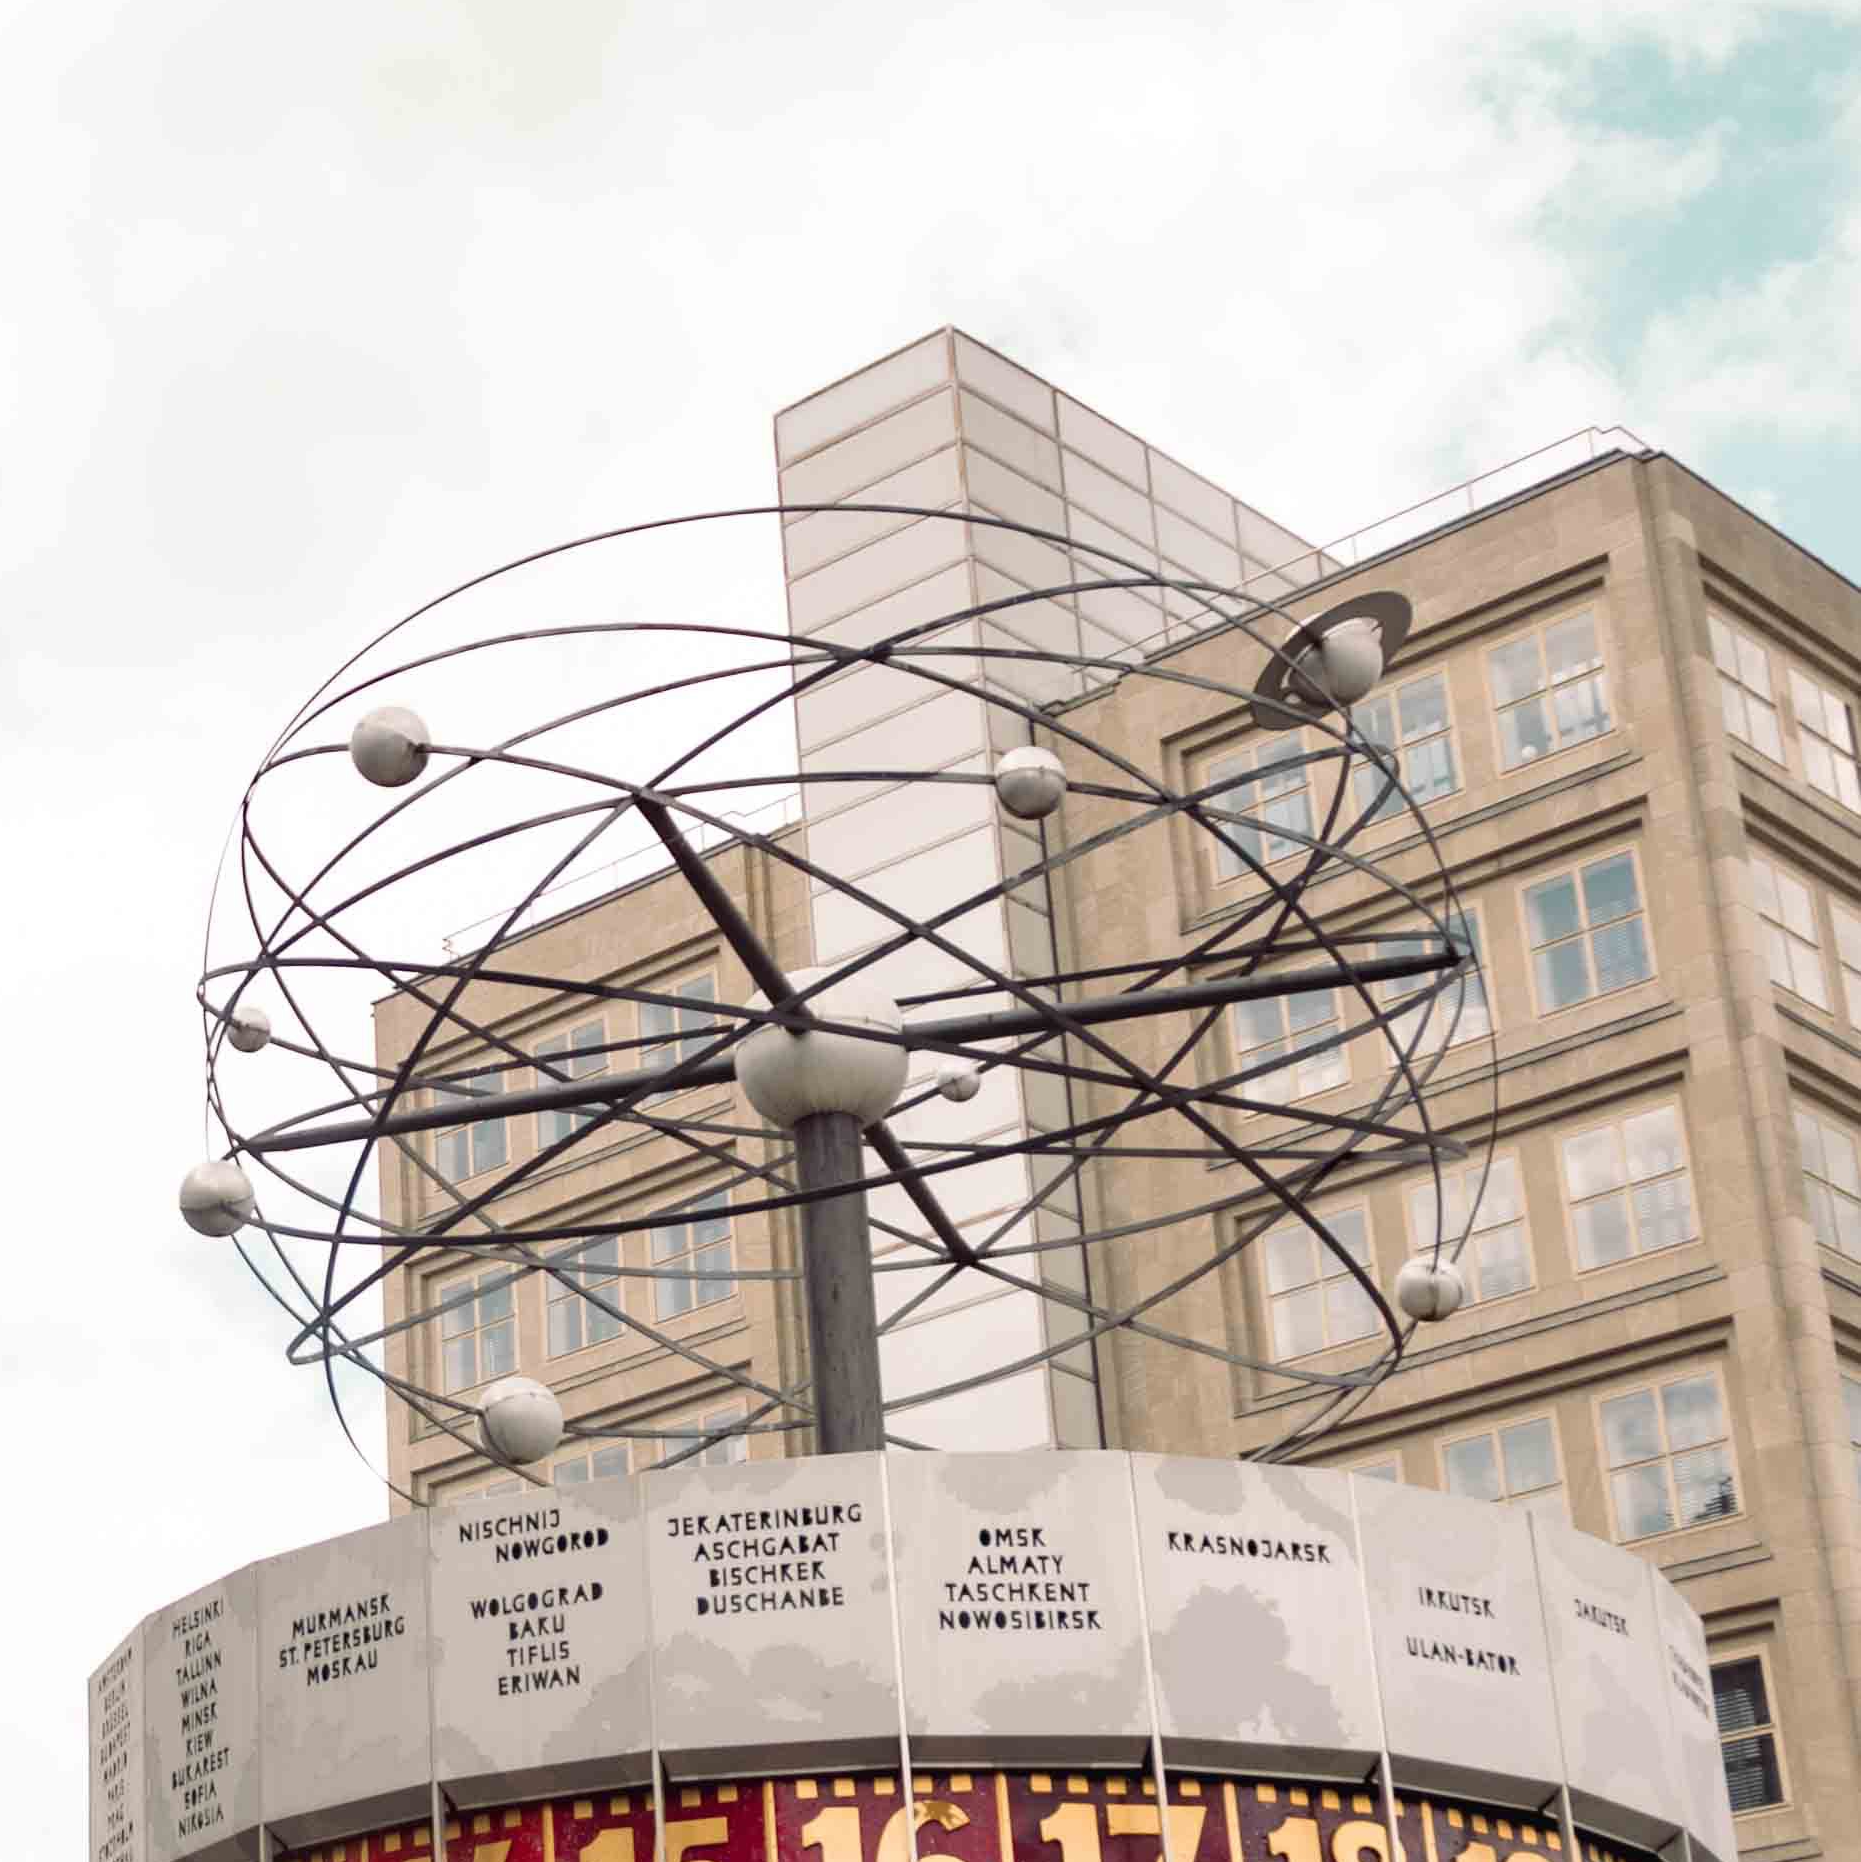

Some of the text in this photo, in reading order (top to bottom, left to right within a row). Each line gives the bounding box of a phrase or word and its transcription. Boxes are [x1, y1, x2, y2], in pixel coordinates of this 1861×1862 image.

[459, 1509, 561, 1543] NISCHNIJ
[667, 1503, 863, 1538] JEKATERINBURG
[496, 1528, 610, 1564] NOWGOROD
[693, 1532, 842, 1564] ASCHGABAT
[978, 1527, 1047, 1548] OMSK
[1167, 1531, 1331, 1564] KRASNOJARSK
[709, 1561, 825, 1588] BISCHKEK
[967, 1555, 1064, 1576] ALMATY
[470, 1582, 604, 1620] WOLGOGRAD
[696, 1587, 845, 1616] DUSCHANBE
[945, 1582, 1091, 1603] TASCHKENT
[1417, 1586, 1496, 1620] IRKUTSK
[172, 1600, 225, 1636] HELSINKI
[292, 1594, 391, 1637] MURMANSK
[509, 1614, 566, 1640] BAKU
[939, 1610, 1103, 1631] NOWOSIBIRSK
[1574, 1598, 1631, 1637] JAKUTSK
[185, 1631, 211, 1658] RIGA
[279, 1616, 406, 1668] ST. PETERSBURG
[506, 1641, 570, 1668] TIFLIS
[1406, 1637, 1521, 1676] ULAN-BATOR
[175, 1650, 222, 1686] TALLINN
[306, 1652, 378, 1687] MOSKAU
[497, 1666, 581, 1696] ERIWAN
[181, 1678, 218, 1708] WILNA
[181, 1702, 218, 1735] MINSK
[186, 1730, 213, 1756] KIEW
[171, 1748, 229, 1790] BUKAREST
[184, 1781, 217, 1810] SOFIA
[178, 1805, 224, 1838] NIKOSIA
